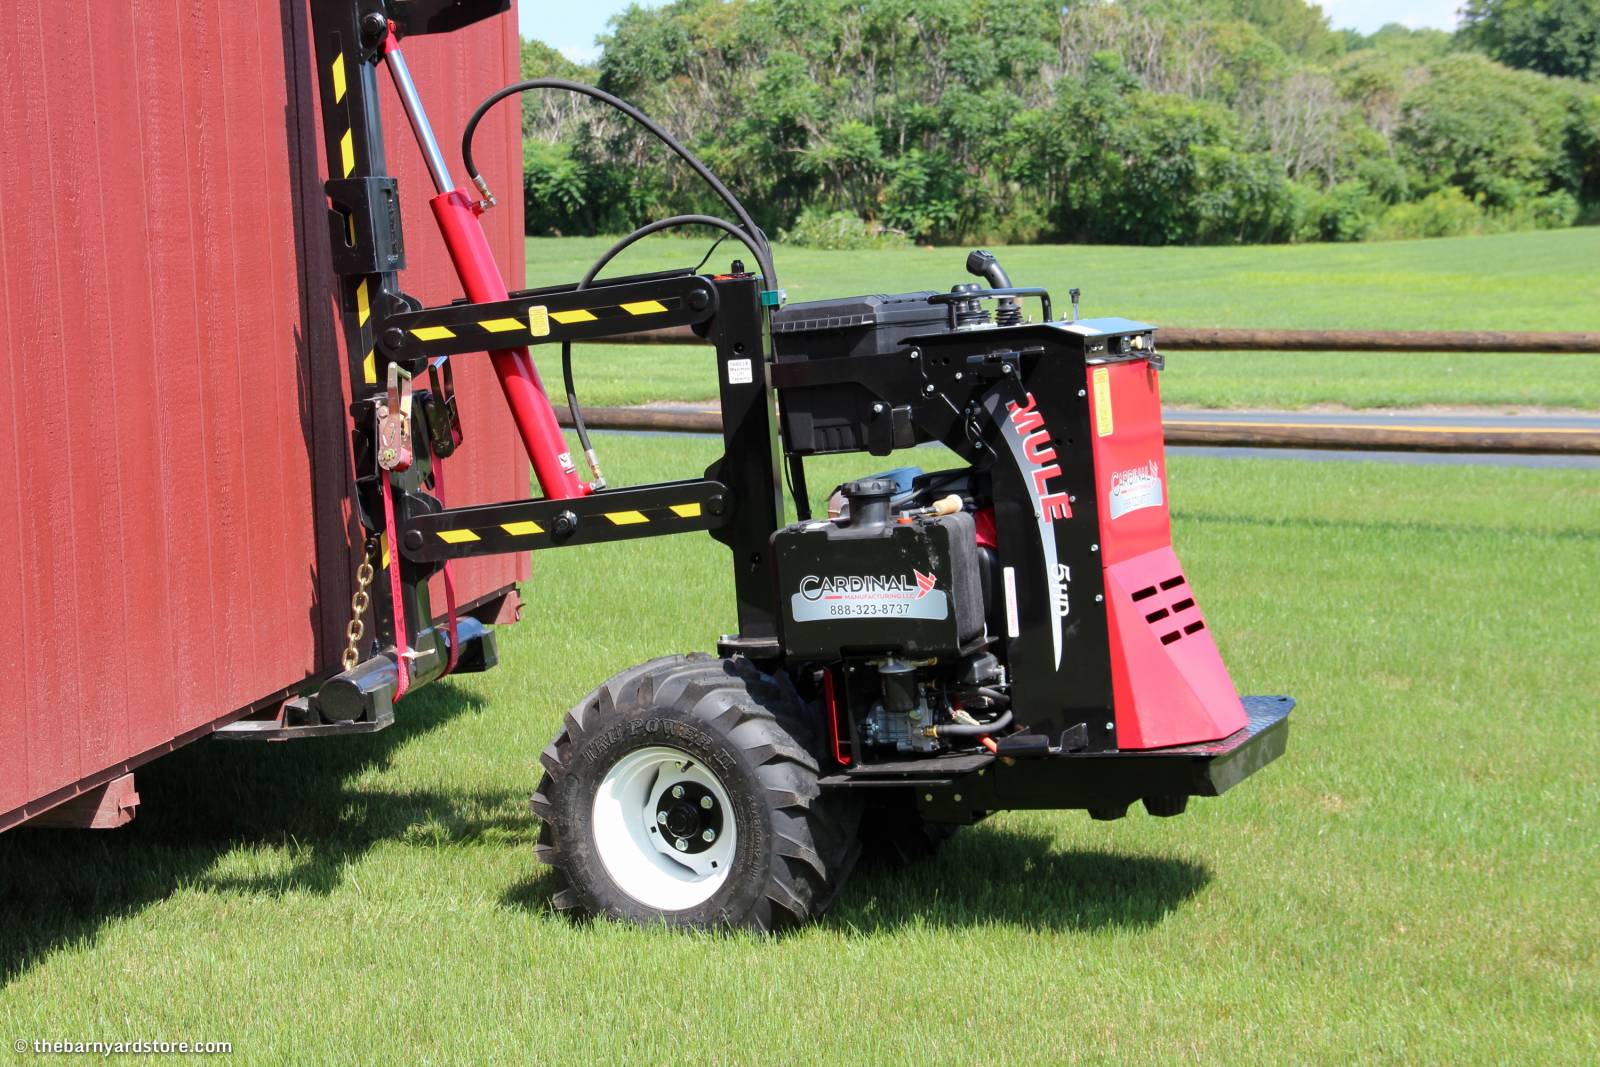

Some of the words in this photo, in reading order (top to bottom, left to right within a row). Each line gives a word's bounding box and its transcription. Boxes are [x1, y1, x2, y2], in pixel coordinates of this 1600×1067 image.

[1005, 391, 1073, 523] MULE
[800, 574, 914, 602] CARDINAL
[830, 603, 910, 616] 888-323-8737
[627, 717, 713, 748] POWER
